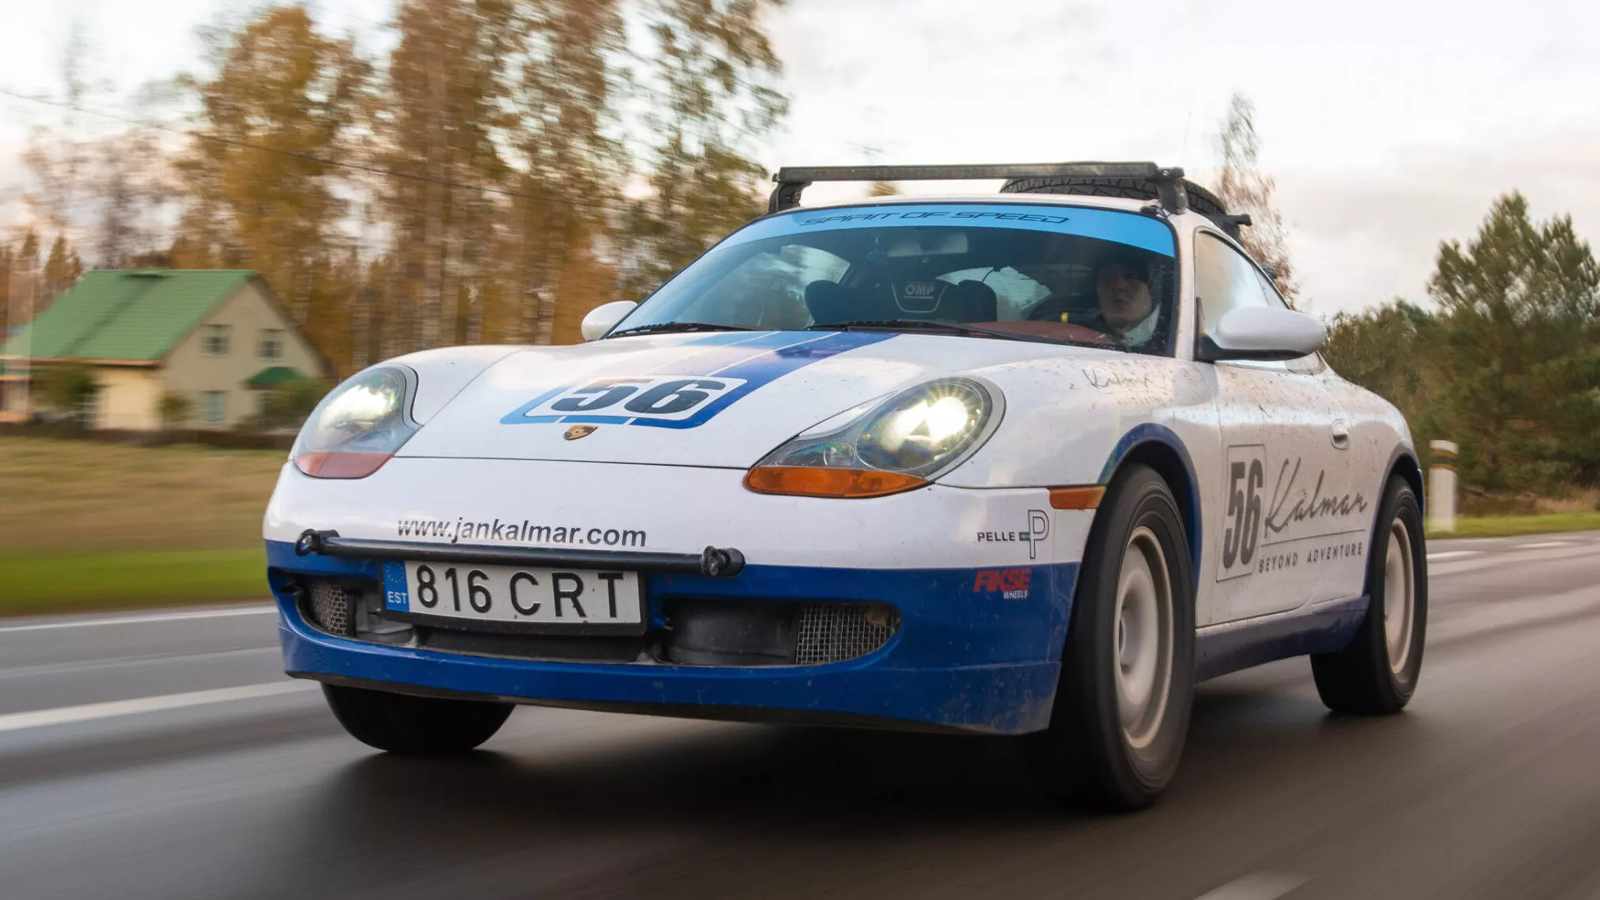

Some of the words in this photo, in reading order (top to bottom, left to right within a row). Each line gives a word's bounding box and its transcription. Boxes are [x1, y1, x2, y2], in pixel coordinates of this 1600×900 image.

[800, 212, 900, 227] SPIRIT
[900, 211, 951, 219] OF
[949, 211, 1070, 224] SPEED
[905, 284, 935, 296] OMP
[550, 378, 727, 415] 56
[1264, 456, 1368, 539] Kalmar
[1222, 458, 1264, 569] 56
[397, 517, 647, 548] www.jankalmar.com
[976, 531, 1016, 542] PELLE
[1258, 552, 1299, 573] BEYOND
[1306, 542, 1363, 563] ADVENTURE
[387, 591, 408, 605] EST
[415, 564, 493, 615] 816
[509, 571, 624, 619] CRT
[1003, 589, 1029, 600] WHEELS
